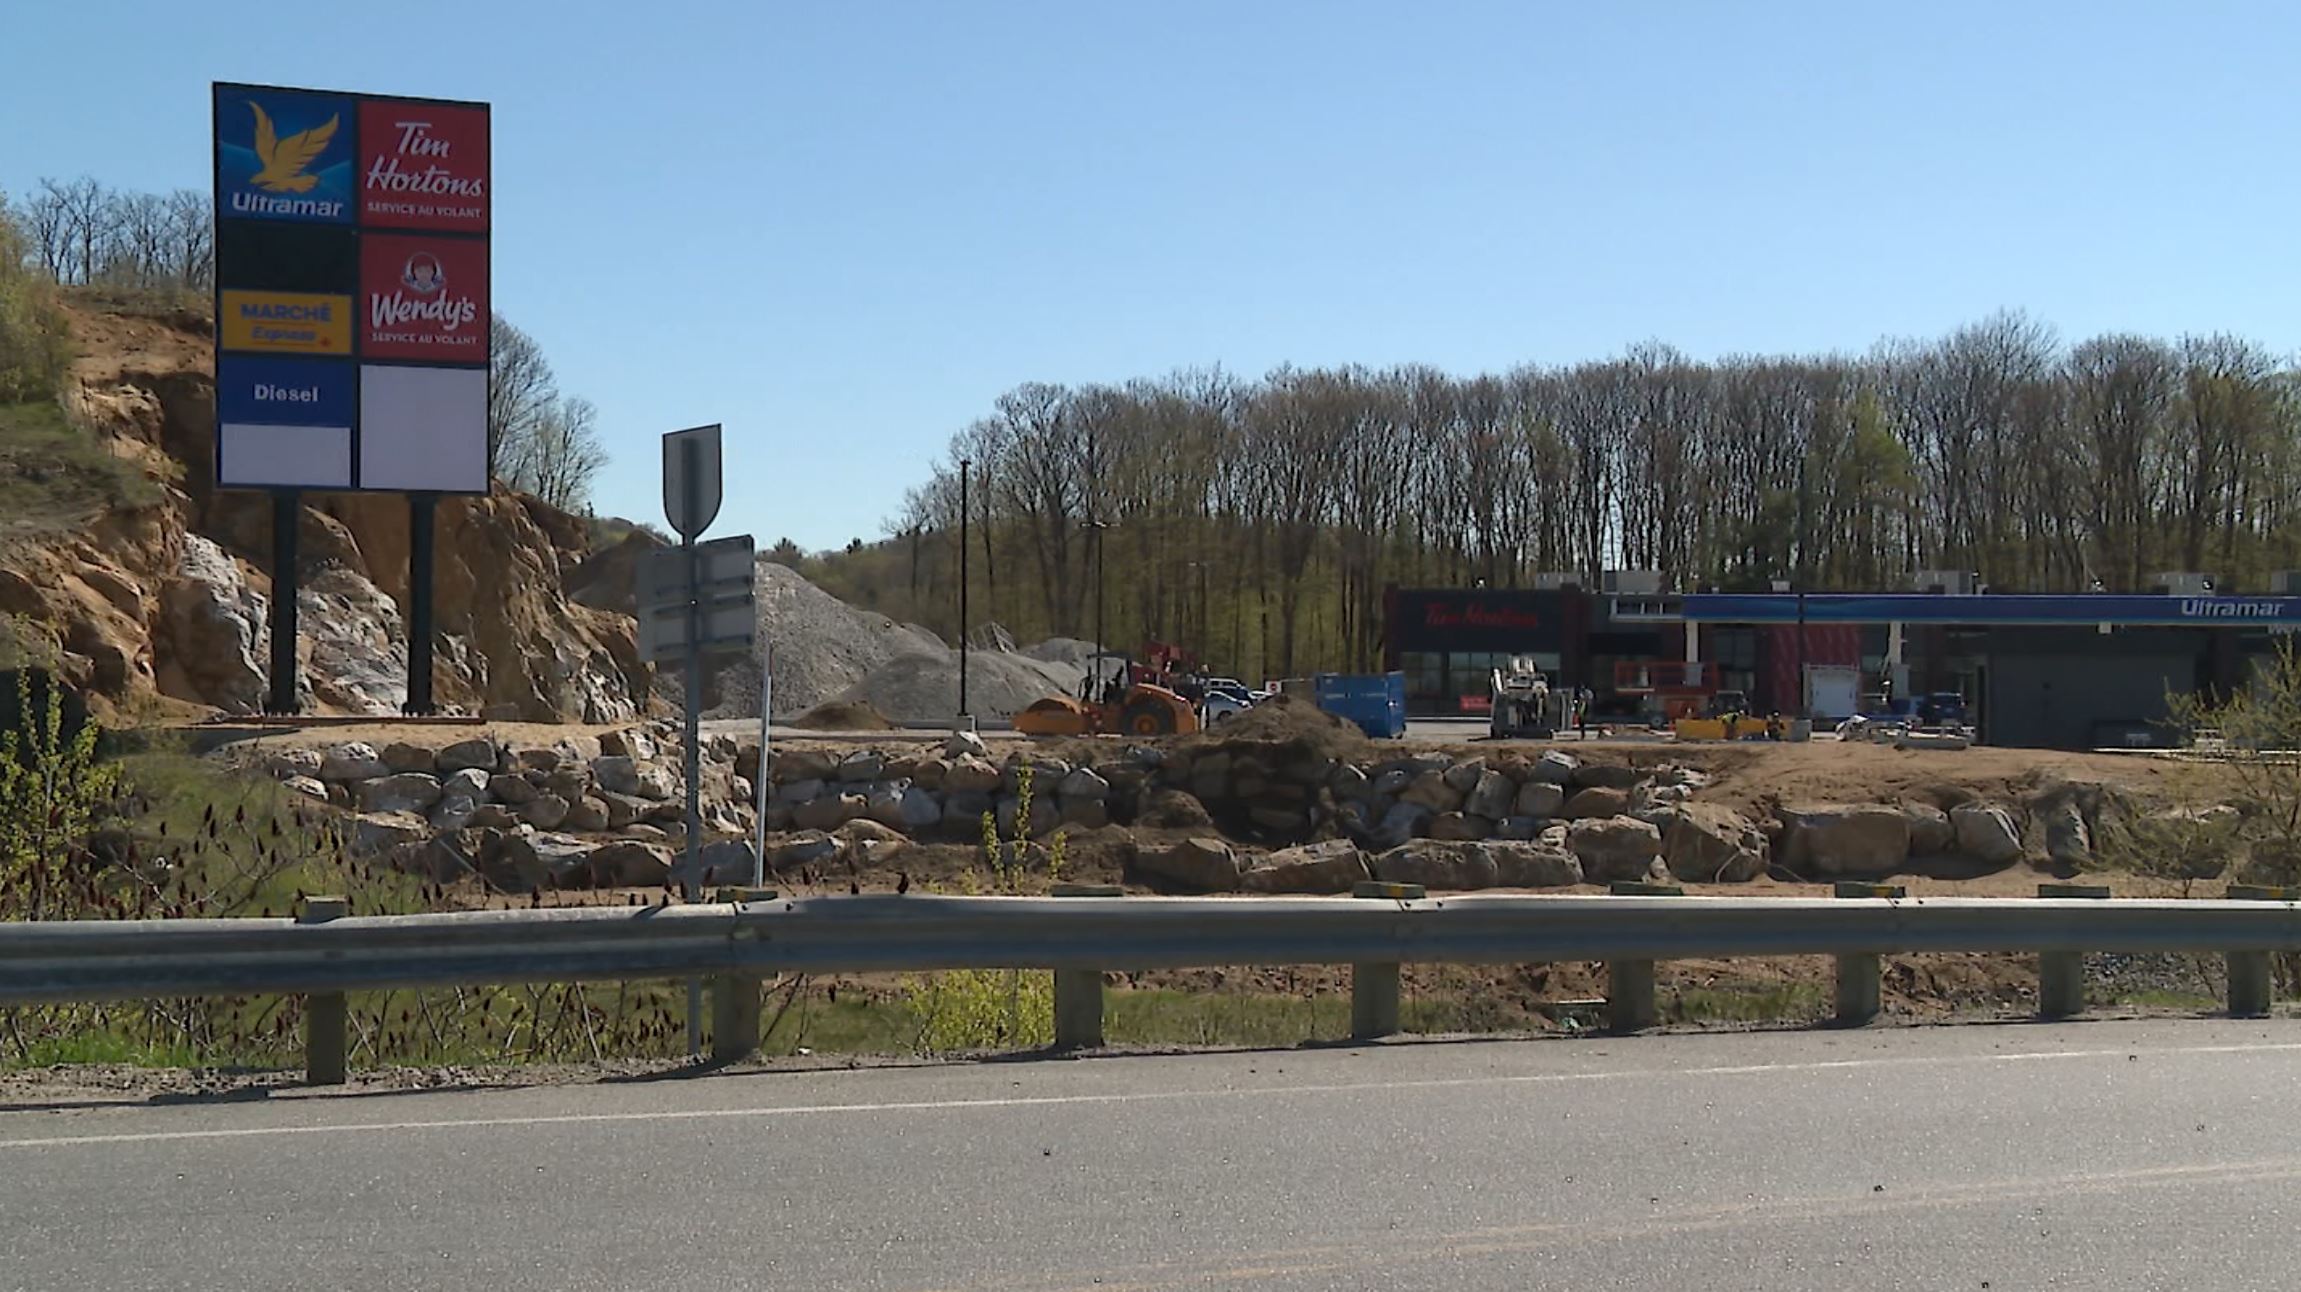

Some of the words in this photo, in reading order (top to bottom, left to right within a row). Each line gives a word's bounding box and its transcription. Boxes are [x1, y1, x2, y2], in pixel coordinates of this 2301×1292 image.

[395, 122, 450, 158] Tim
[367, 154, 482, 197] Hortons
[231, 191, 343, 217] Ultramar
[368, 202, 416, 214] SERVICE
[417, 205, 434, 216] AU
[436, 207, 481, 218] VOLANT
[241, 303, 331, 322] MARCHÉ
[371, 289, 476, 331] Wendy's
[418, 334, 432, 344] AU
[253, 383, 318, 402] Diesel
[2181, 599, 2284, 617] Ultramar
